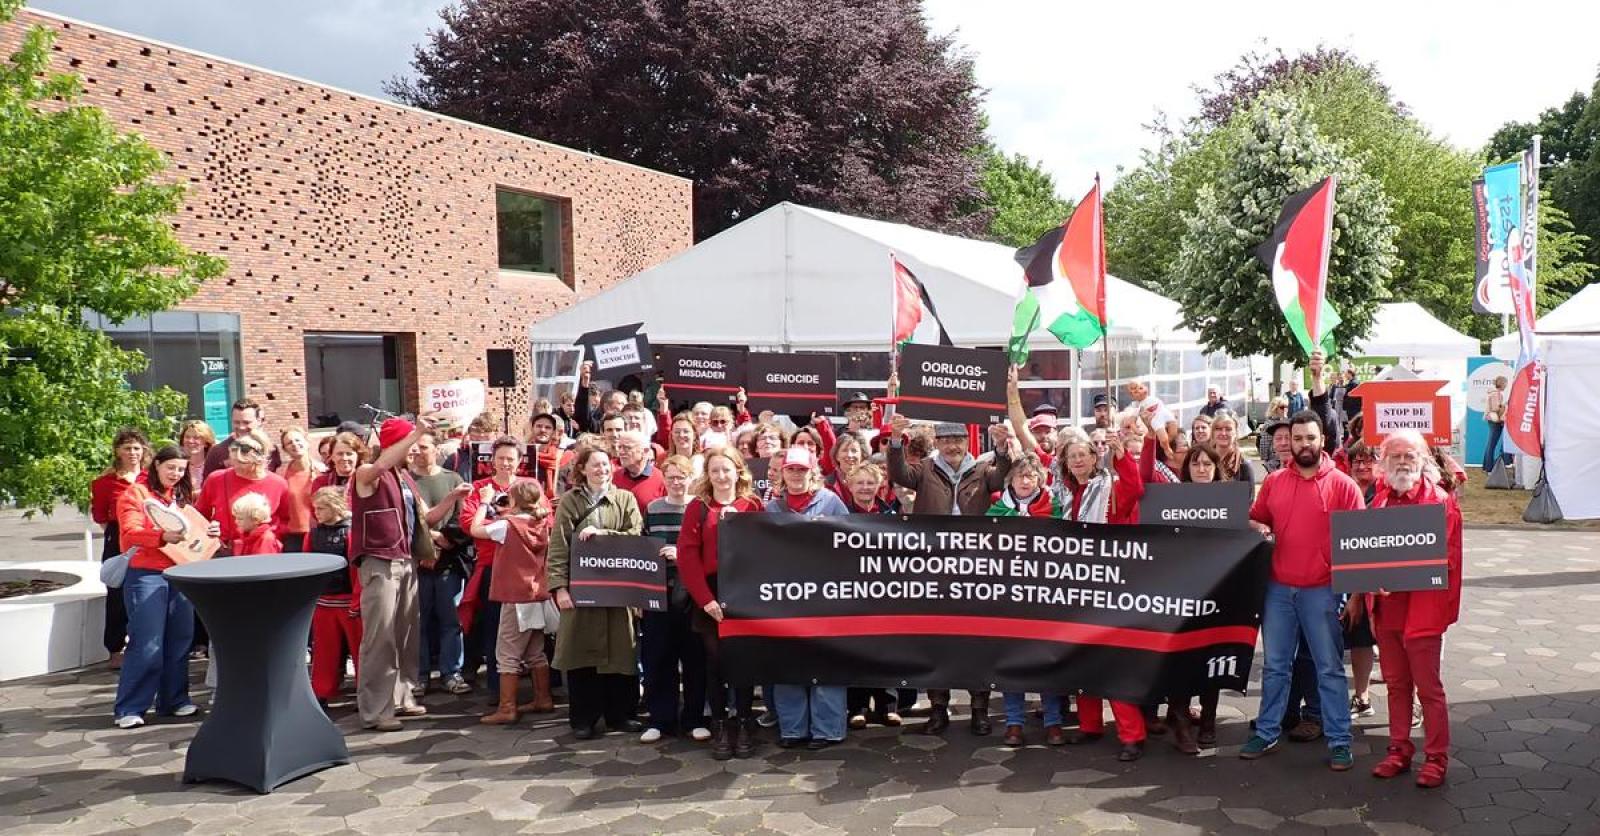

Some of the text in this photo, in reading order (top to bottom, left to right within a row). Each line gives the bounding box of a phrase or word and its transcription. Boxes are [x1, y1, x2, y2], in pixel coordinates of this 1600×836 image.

[678, 359, 727, 370] OORLOGS-
[921, 361, 988, 377] OORLOGS-
[679, 368, 726, 379] MISDADEN
[766, 373, 820, 385] GENOCIDE
[921, 376, 986, 392] MISDADEN
[432, 388, 462, 398] Stop
[1383, 407, 1426, 416] STOP DE
[1380, 420, 1430, 429] GENOCIDE
[1161, 508, 1228, 520] GENOCIDE
[832, 531, 1153, 561] POLITICI, TREK DE RODE LIJN.
[1340, 533, 1437, 550] HONGERDOOD
[579, 556, 658, 572] HONGERDOOD
[859, 553, 1126, 585] IN WOORDEN ÉN DADEN.
[759, 581, 1221, 617] STOP GENOCIDE. STOP STRAFFELOOSHEID.
